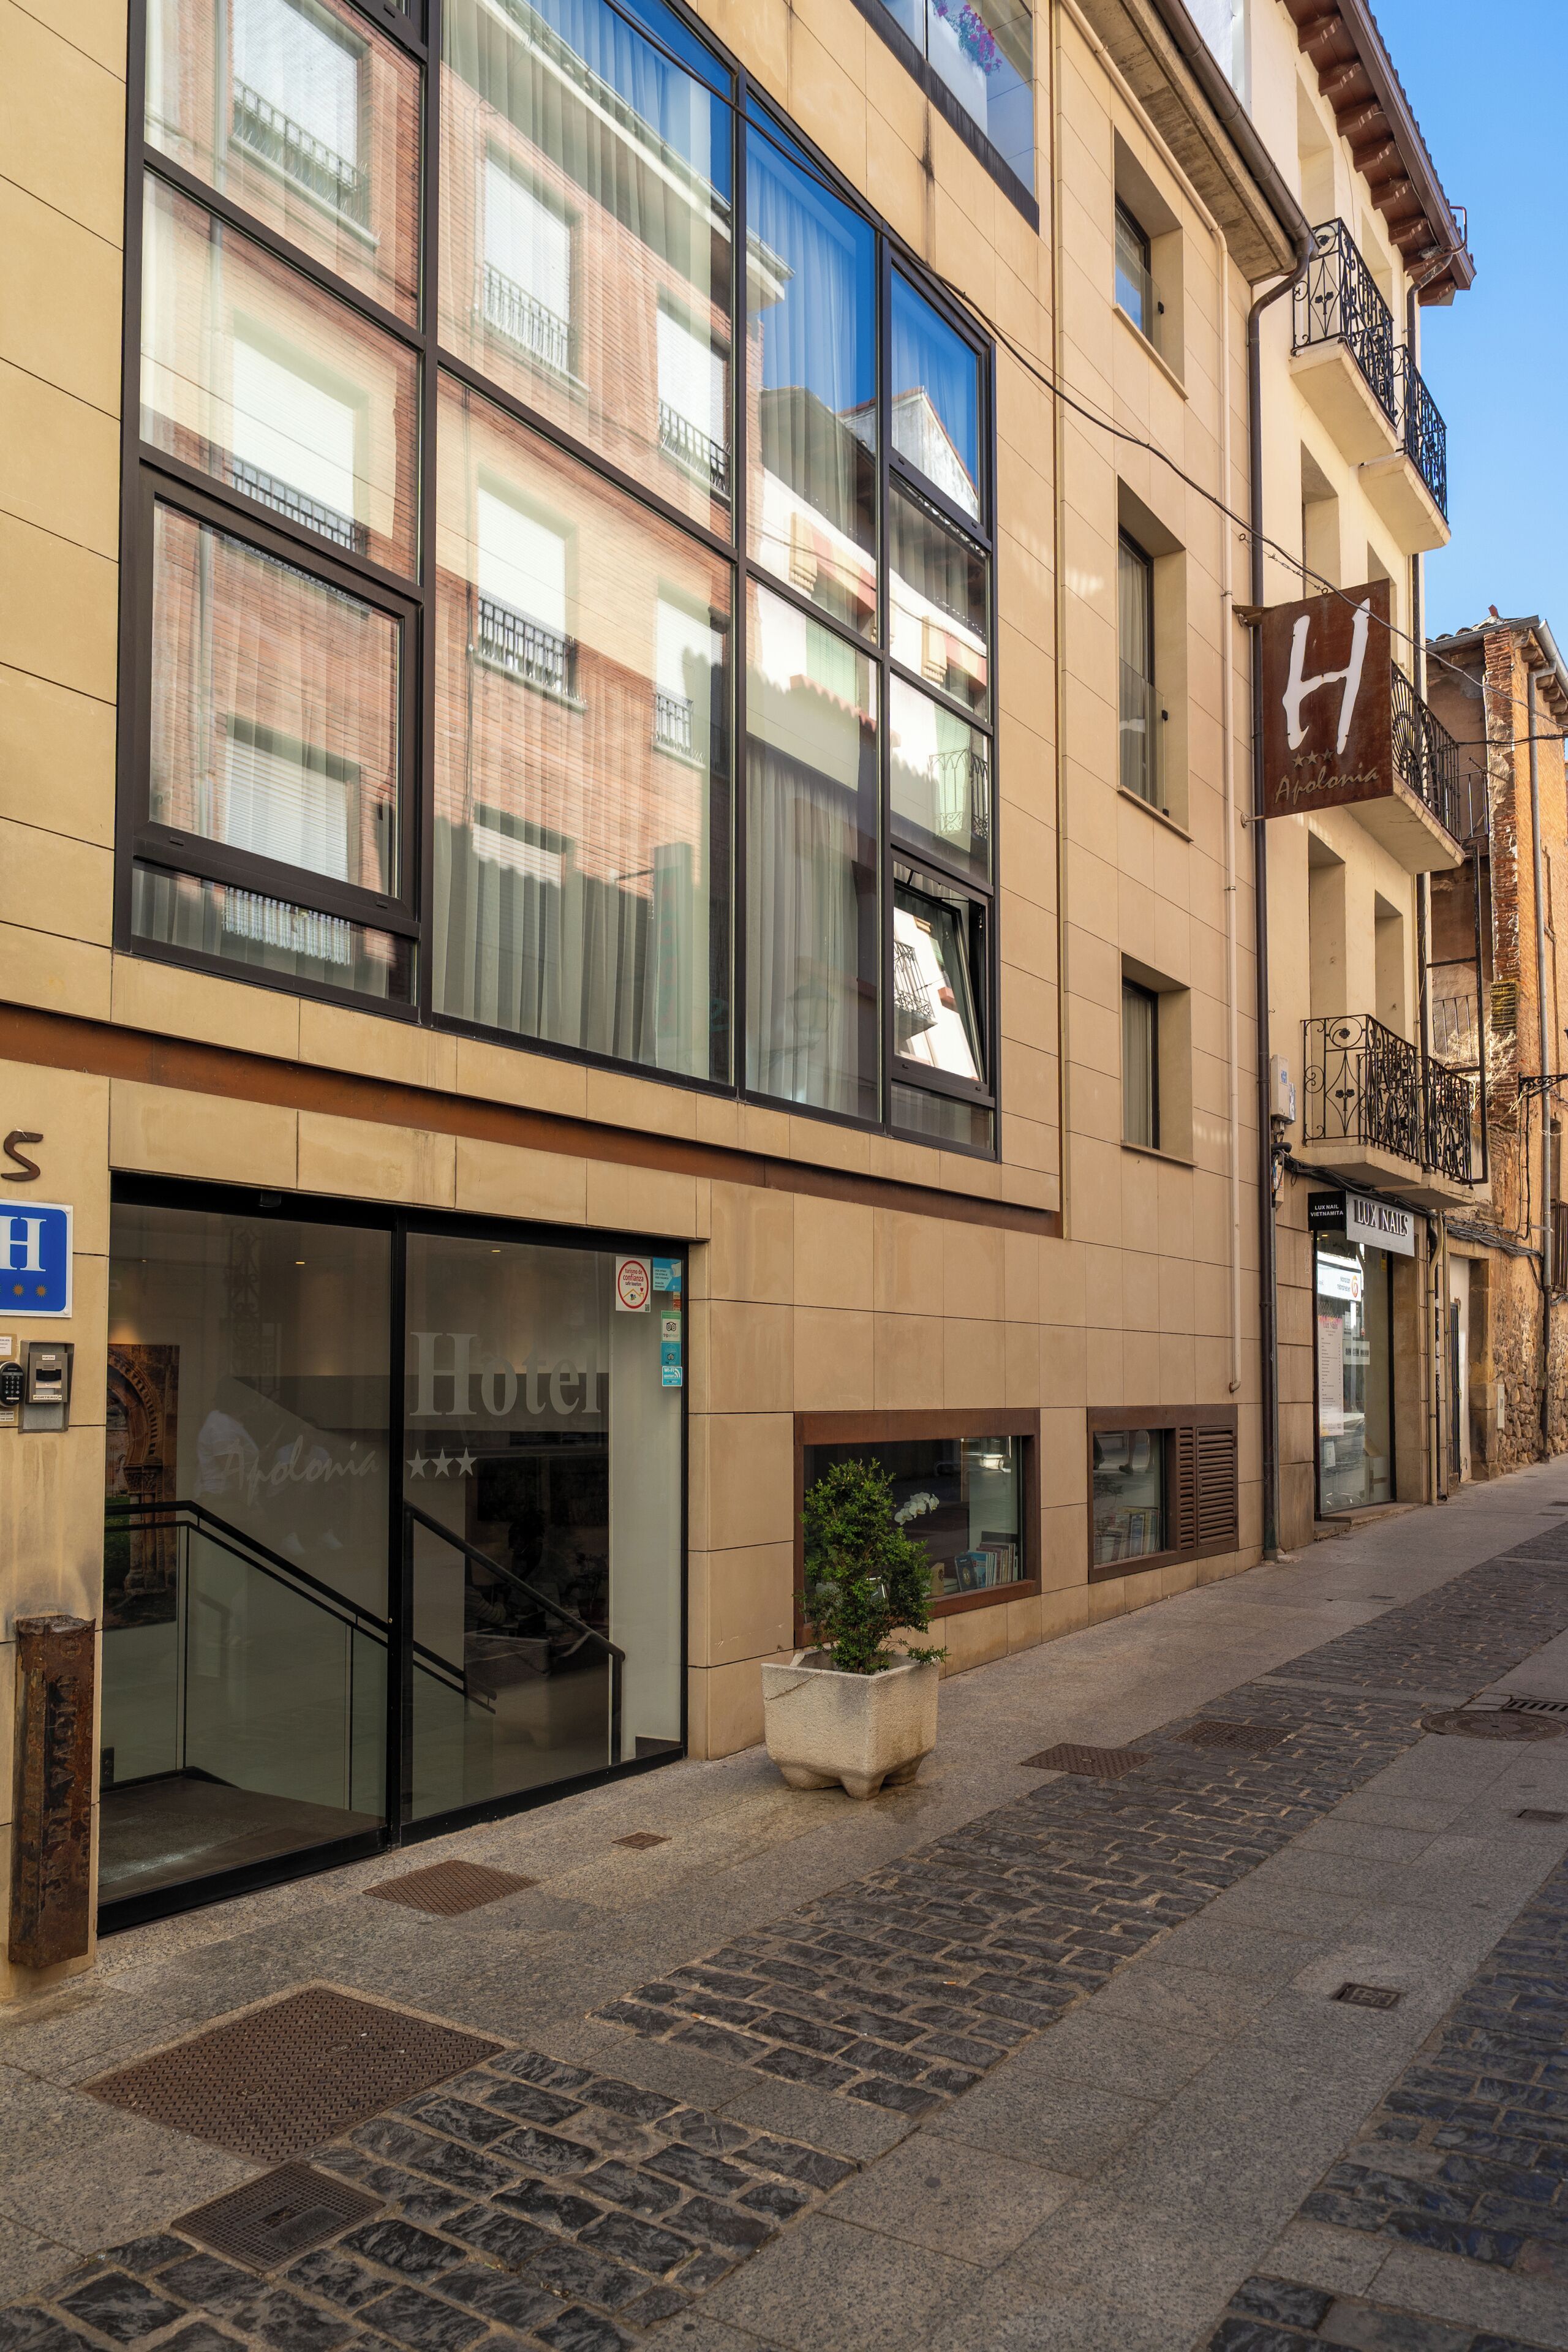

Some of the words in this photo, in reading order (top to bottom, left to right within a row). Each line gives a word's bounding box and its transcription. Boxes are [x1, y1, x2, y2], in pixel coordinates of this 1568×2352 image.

[1282, 597, 1371, 756] H
[1274, 762, 1379, 807] Apolonia
[0, 1216, 47, 1272] H
[1354, 1199, 1377, 1227] LUX
[1379, 1207, 1409, 1237] NAILS
[410, 1331, 601, 1416] Hotel
[221, 1434, 380, 1505] Apolonia
